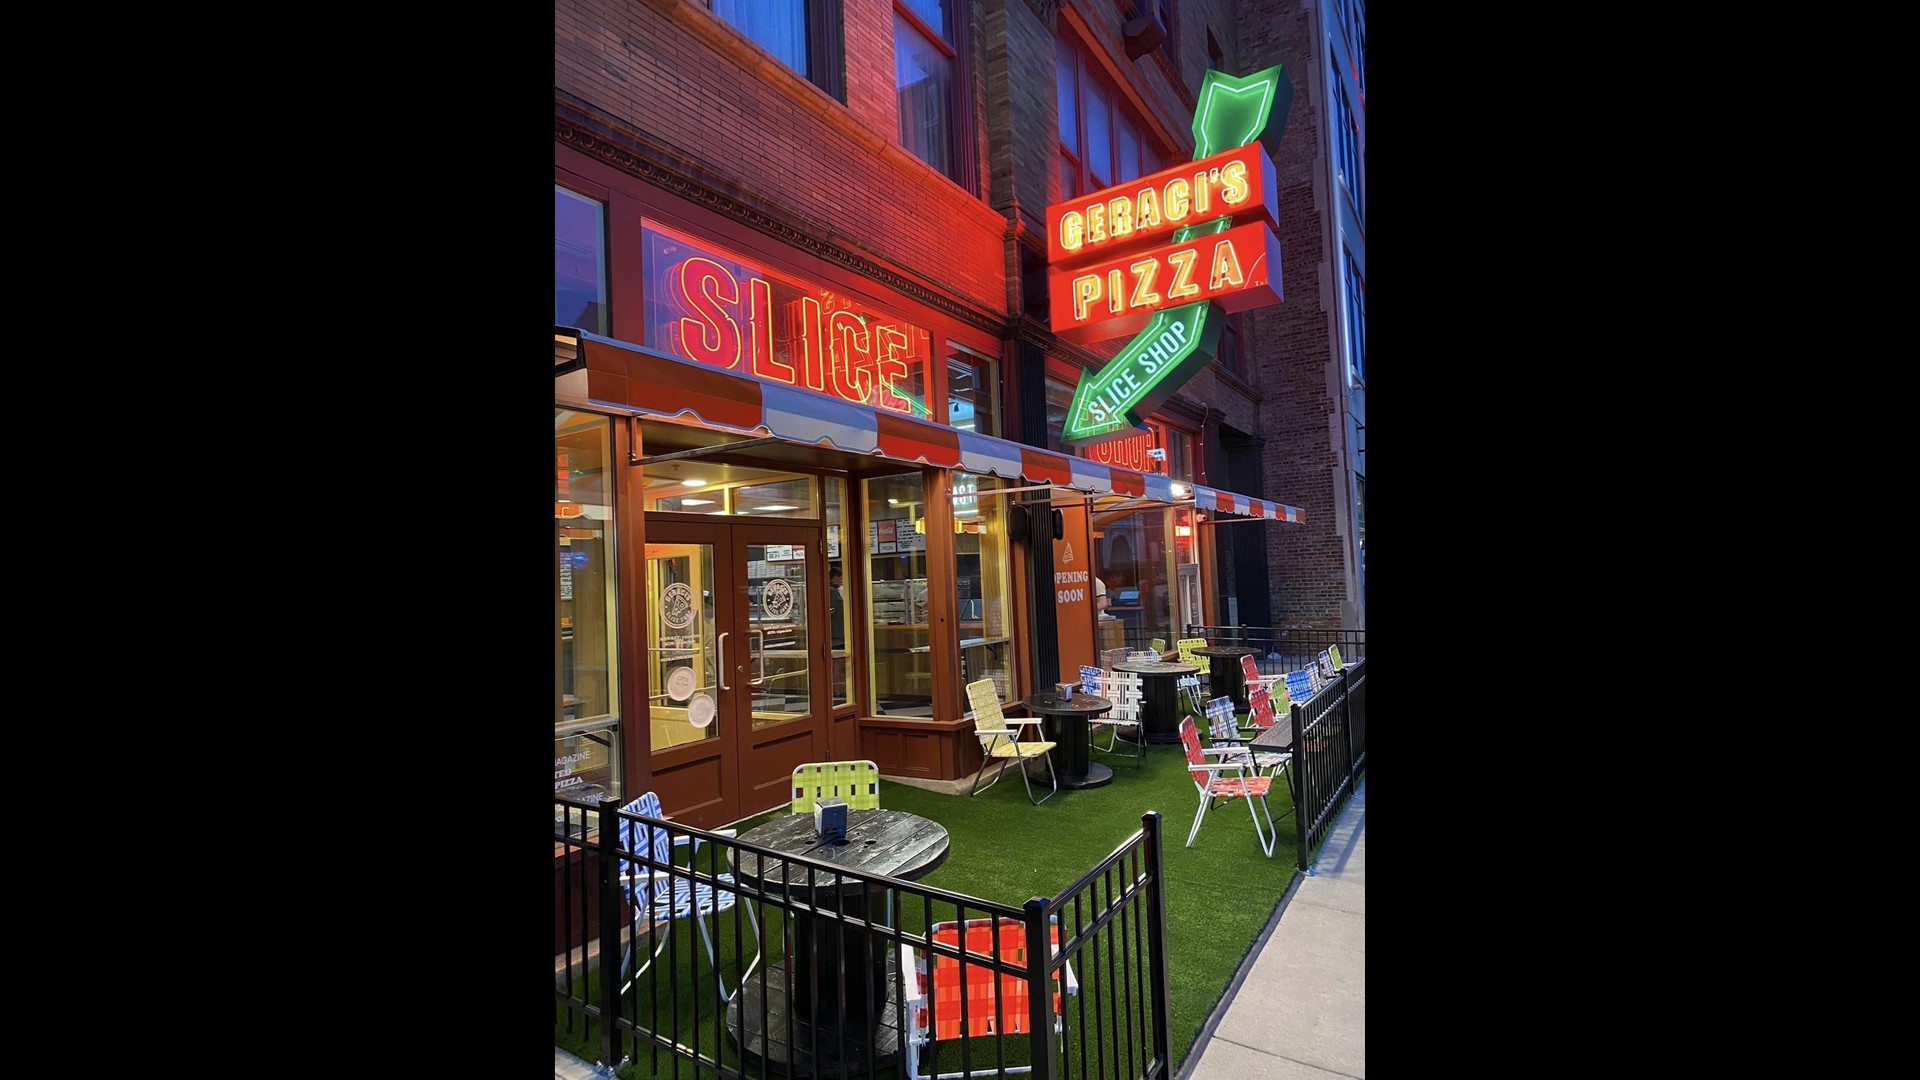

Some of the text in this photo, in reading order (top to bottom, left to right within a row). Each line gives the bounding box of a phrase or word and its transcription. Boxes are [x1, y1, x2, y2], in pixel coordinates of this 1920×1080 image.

[1060, 160, 1249, 252] GERACI'S
[1073, 239, 1245, 321] PIZZA
[680, 256, 911, 414] SLICE
[1088, 321, 1187, 423] SLICE SHOP
[1057, 588, 1084, 604] SOON
[555, 776, 584, 790] PIZZA
